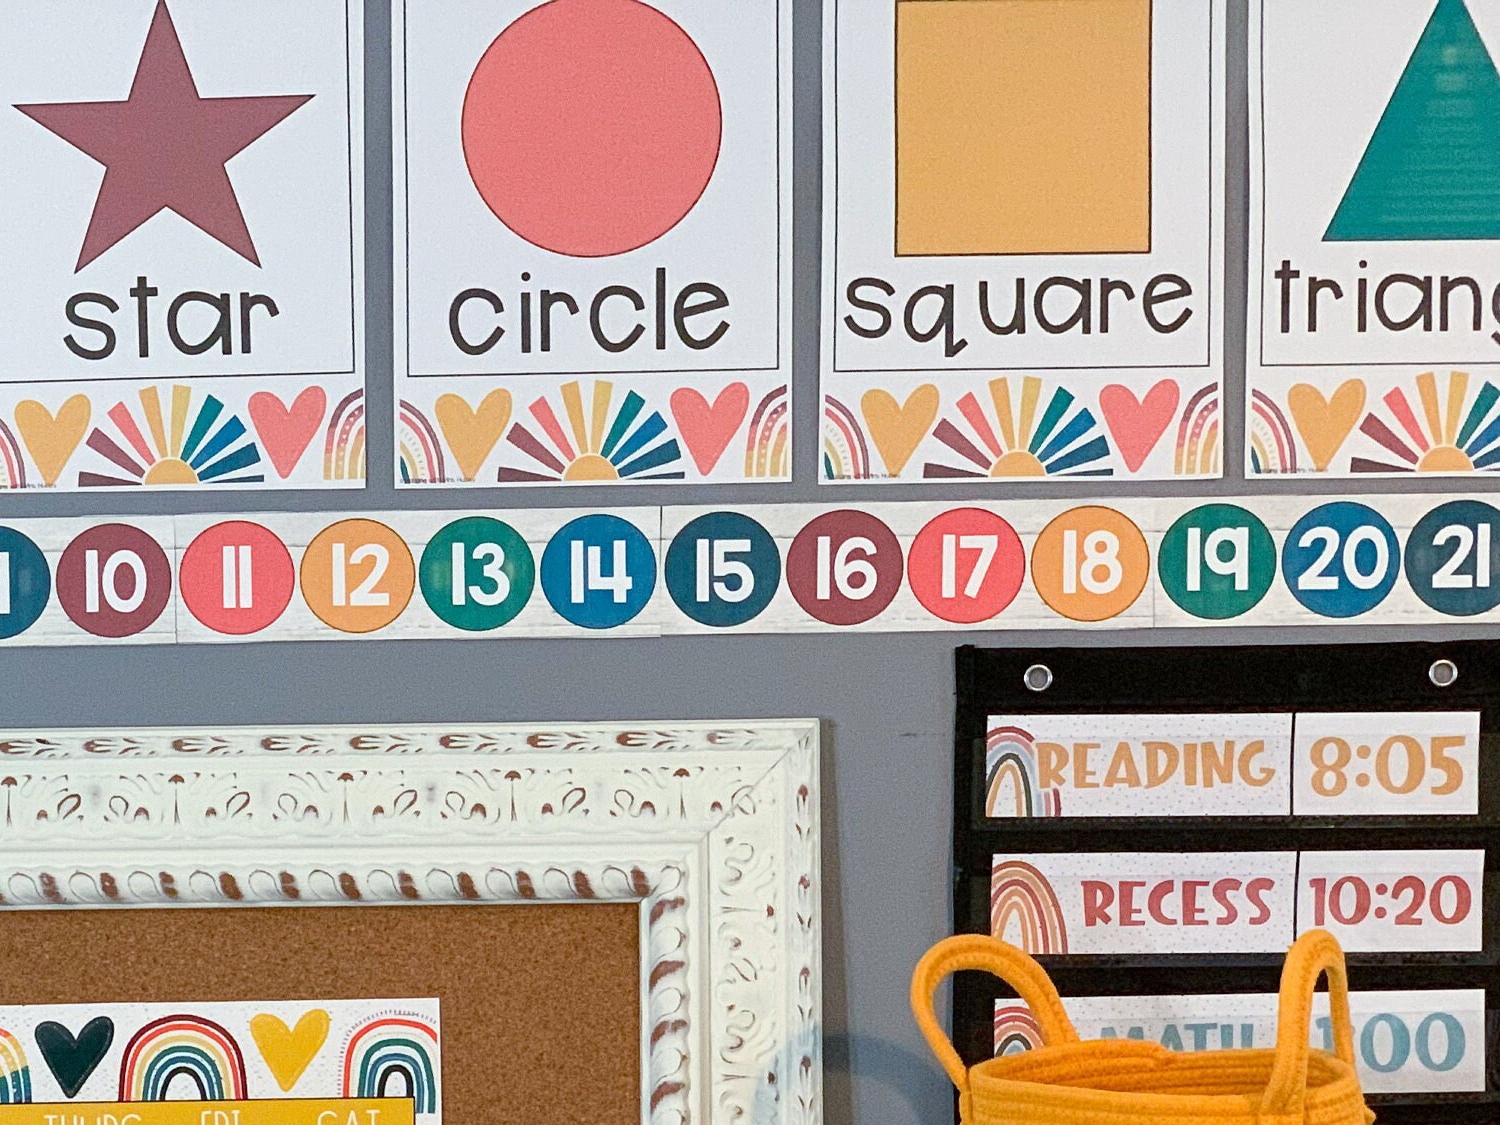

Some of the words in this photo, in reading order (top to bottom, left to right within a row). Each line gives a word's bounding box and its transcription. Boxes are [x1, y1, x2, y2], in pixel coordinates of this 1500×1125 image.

[62, 275, 279, 361] star
[448, 267, 730, 355] circle
[844, 272, 1194, 358] square
[1274, 259, 1500, 346] trian
[84, 549, 147, 614] 10
[222, 546, 251, 609] 11
[331, 543, 390, 607] 12
[452, 542, 511, 606] 13
[570, 540, 633, 604] 14
[696, 538, 754, 603] 15
[817, 536, 878, 600] 16
[941, 534, 998, 599] 17
[1062, 530, 1123, 594] 18
[1186, 527, 1248, 591] 19
[1297, 526, 1389, 590] 20
[1431, 524, 1490, 588] 21
[1035, 740, 1276, 790] READING
[1310, 735, 1467, 798] 8:05
[1081, 877, 1275, 927] RECESS
[1309, 875, 1472, 928] 10:20
